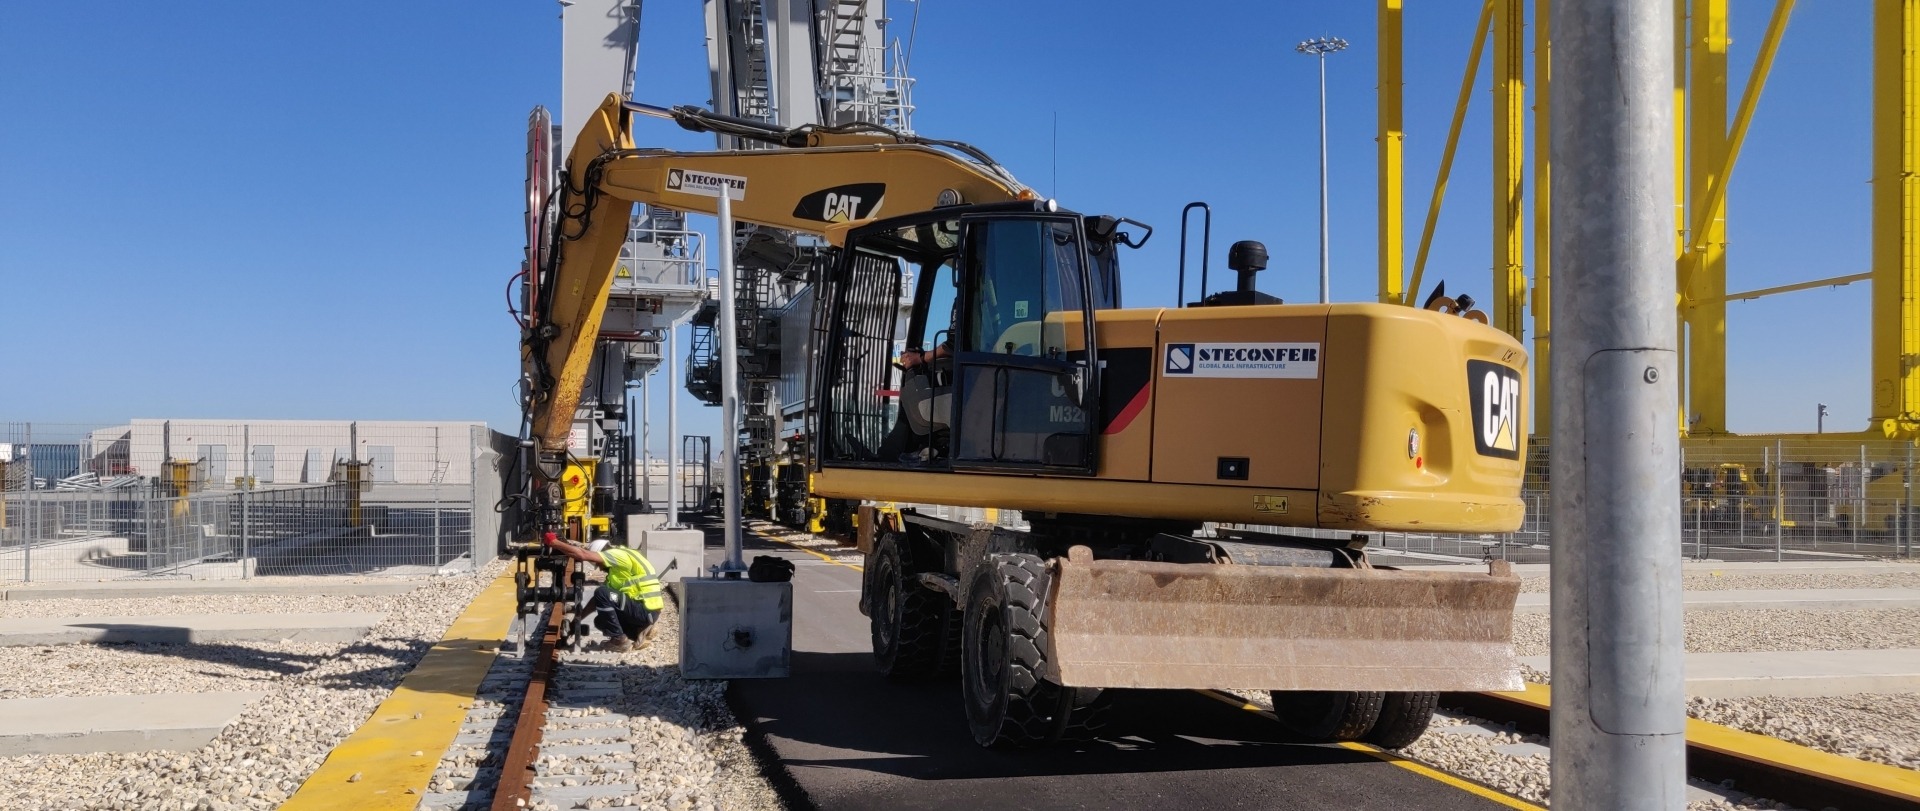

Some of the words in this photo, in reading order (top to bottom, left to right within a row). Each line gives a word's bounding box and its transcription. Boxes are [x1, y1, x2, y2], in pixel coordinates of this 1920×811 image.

[823, 192, 861, 221] CAT
[1199, 348, 1317, 362] STECONFER
[1483, 370, 1519, 452] CAT
